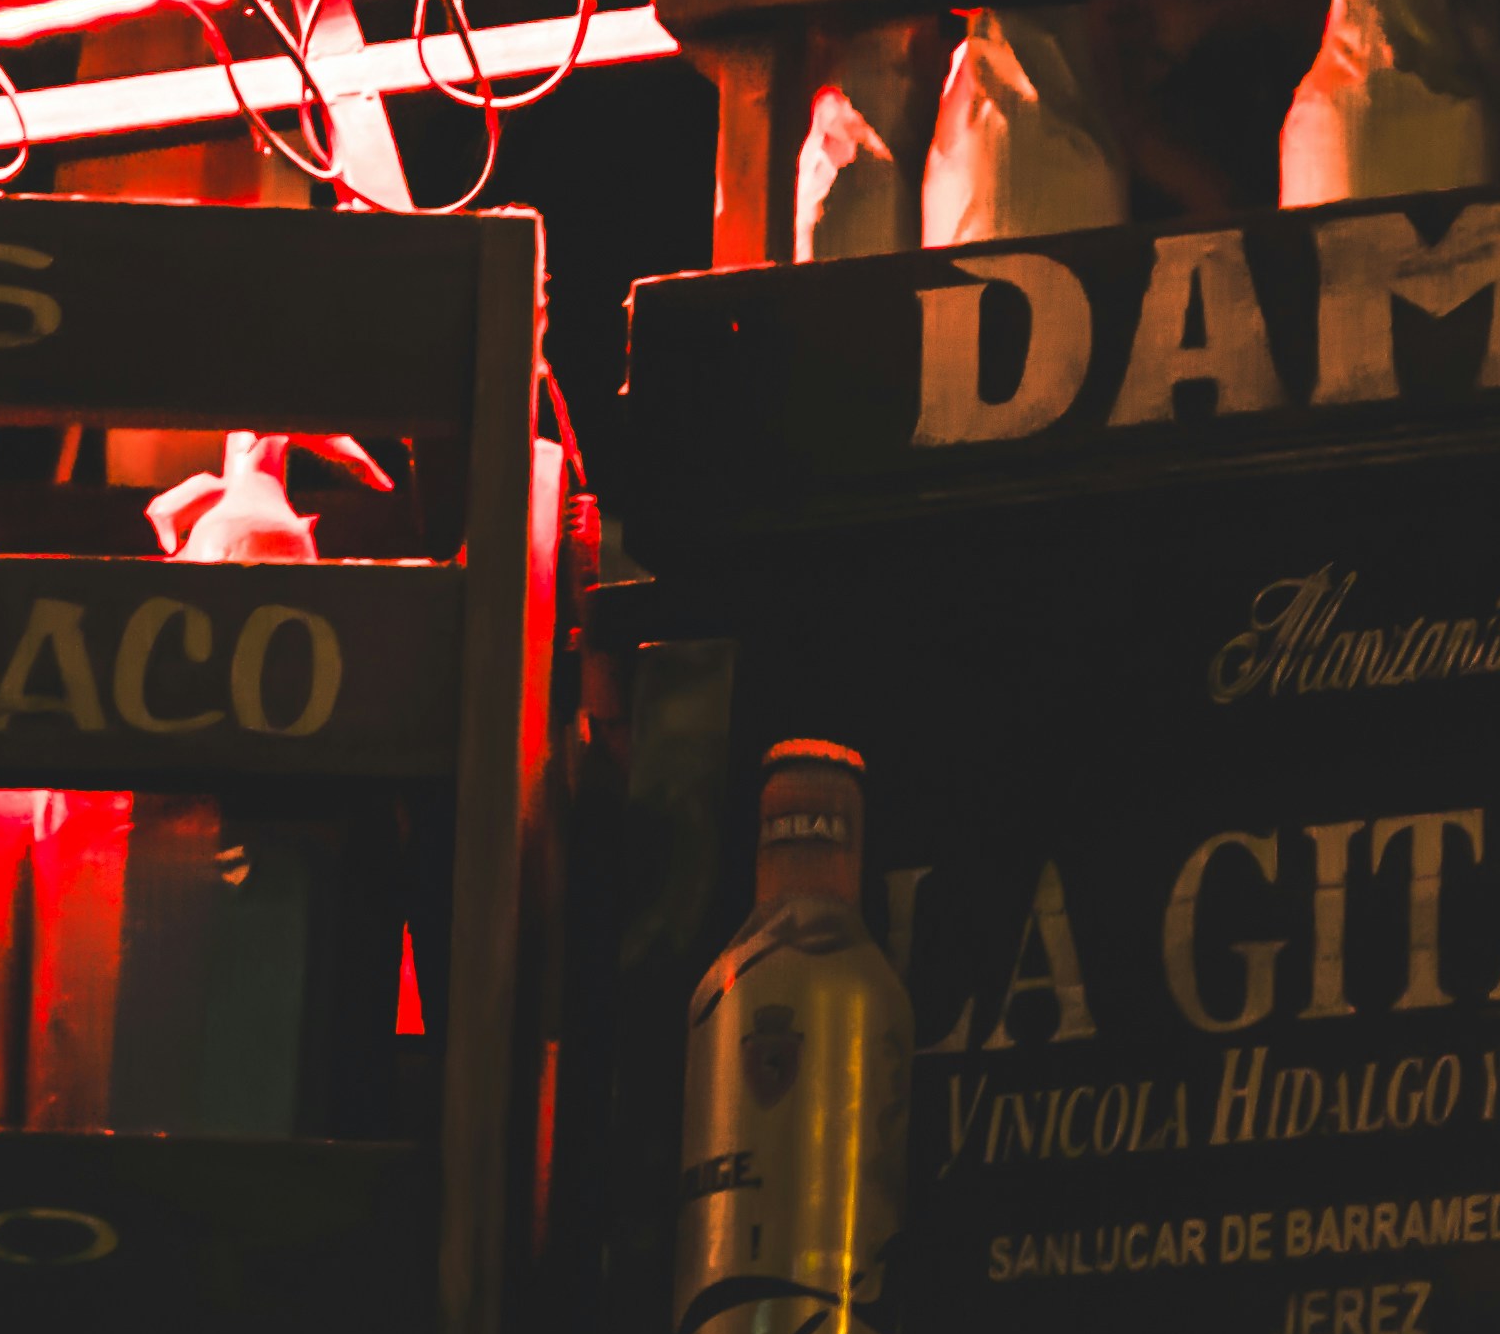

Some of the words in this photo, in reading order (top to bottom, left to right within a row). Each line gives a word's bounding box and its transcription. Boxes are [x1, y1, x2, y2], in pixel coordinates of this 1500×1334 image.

[883, 858, 1098, 1056] LA
[938, 1072, 1189, 1180] VINICOLA
[1209, 1046, 1462, 1146] HIDALGO
[1220, 1211, 1274, 1265] DE
